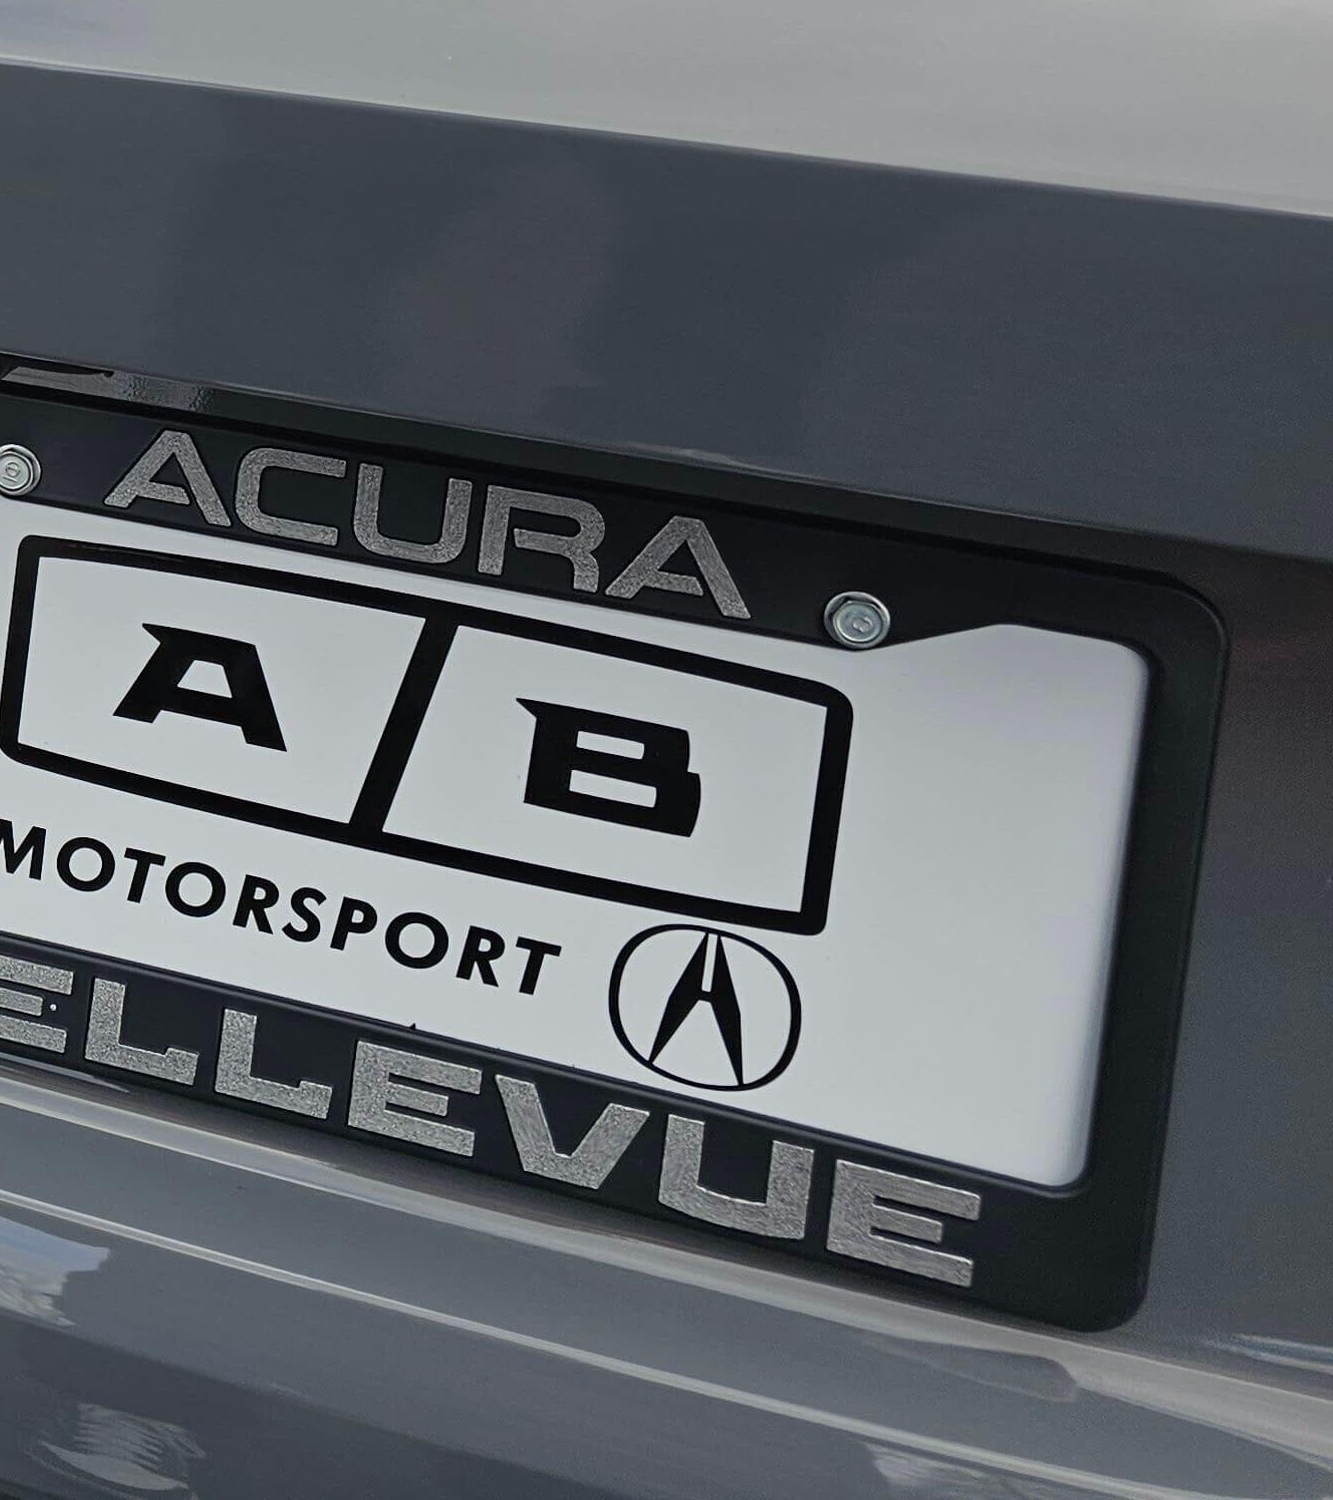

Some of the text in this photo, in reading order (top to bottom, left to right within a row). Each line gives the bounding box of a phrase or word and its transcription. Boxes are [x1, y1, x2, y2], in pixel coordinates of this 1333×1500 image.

[103, 429, 751, 620] ACURA
[112, 623, 701, 836] A B
